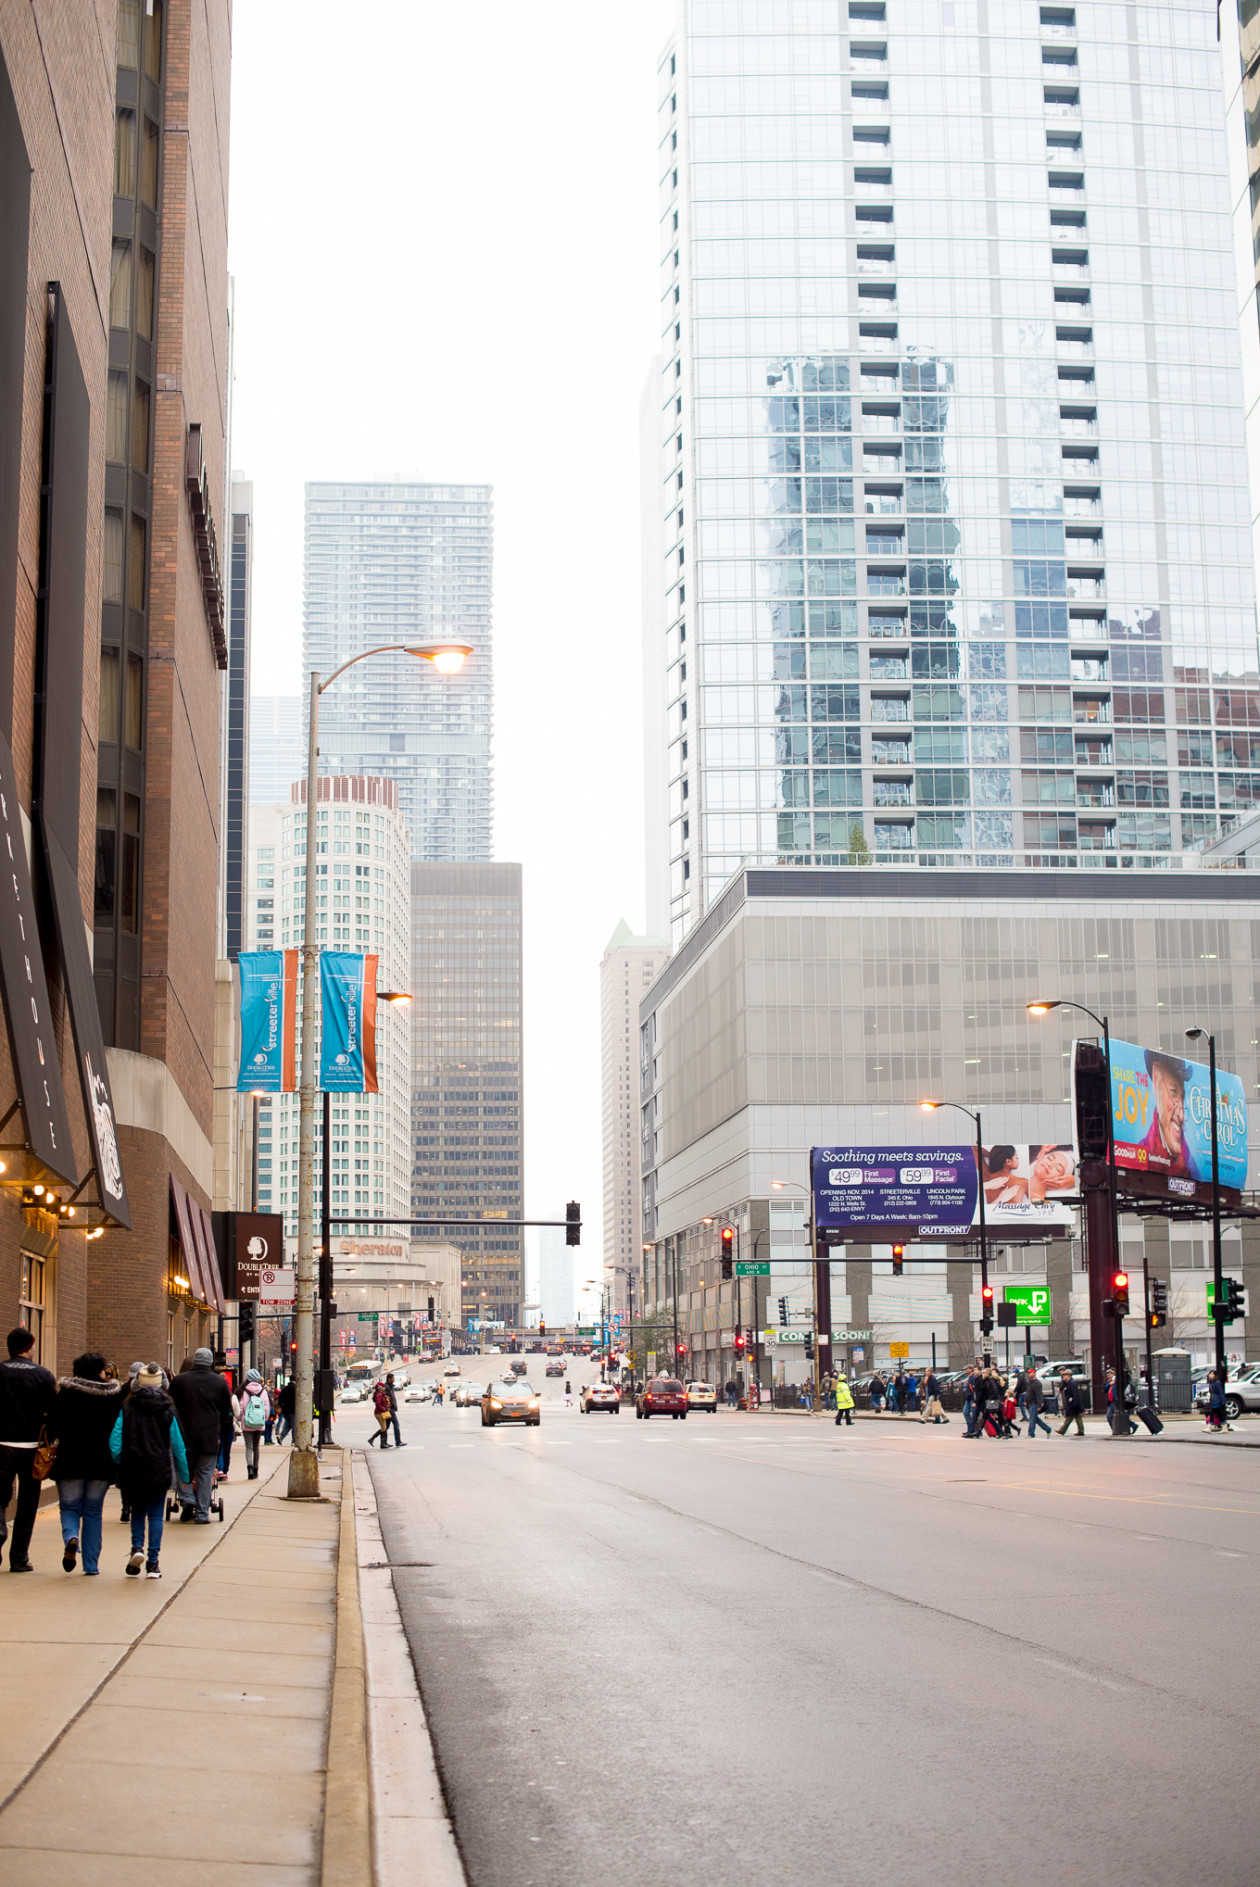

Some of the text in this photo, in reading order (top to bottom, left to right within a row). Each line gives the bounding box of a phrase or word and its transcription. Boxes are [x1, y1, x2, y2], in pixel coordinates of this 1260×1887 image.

[0, 774, 57, 1149] RKETHOUSE
[262, 982, 279, 1052] streeterville
[342, 984, 358, 1053] streeterville
[1112, 1066, 1149, 1087] SHARE THE
[1115, 1084, 1149, 1126] JOY
[1203, 1119, 1235, 1151] CROL
[822, 1150, 964, 1165] Soothing meets savings.
[1169, 1178, 1195, 1192] OUTFRONT
[993, 1200, 1030, 1212] Massage
[871, 1213, 885, 1221] Days
[920, 1226, 968, 1234] OUTFRONT
[339, 1240, 403, 1256] Sheraton
[1009, 1298, 1028, 1306] PARK
[833, 1331, 871, 1341] SOON!
[765, 1340, 776, 1348] 30
